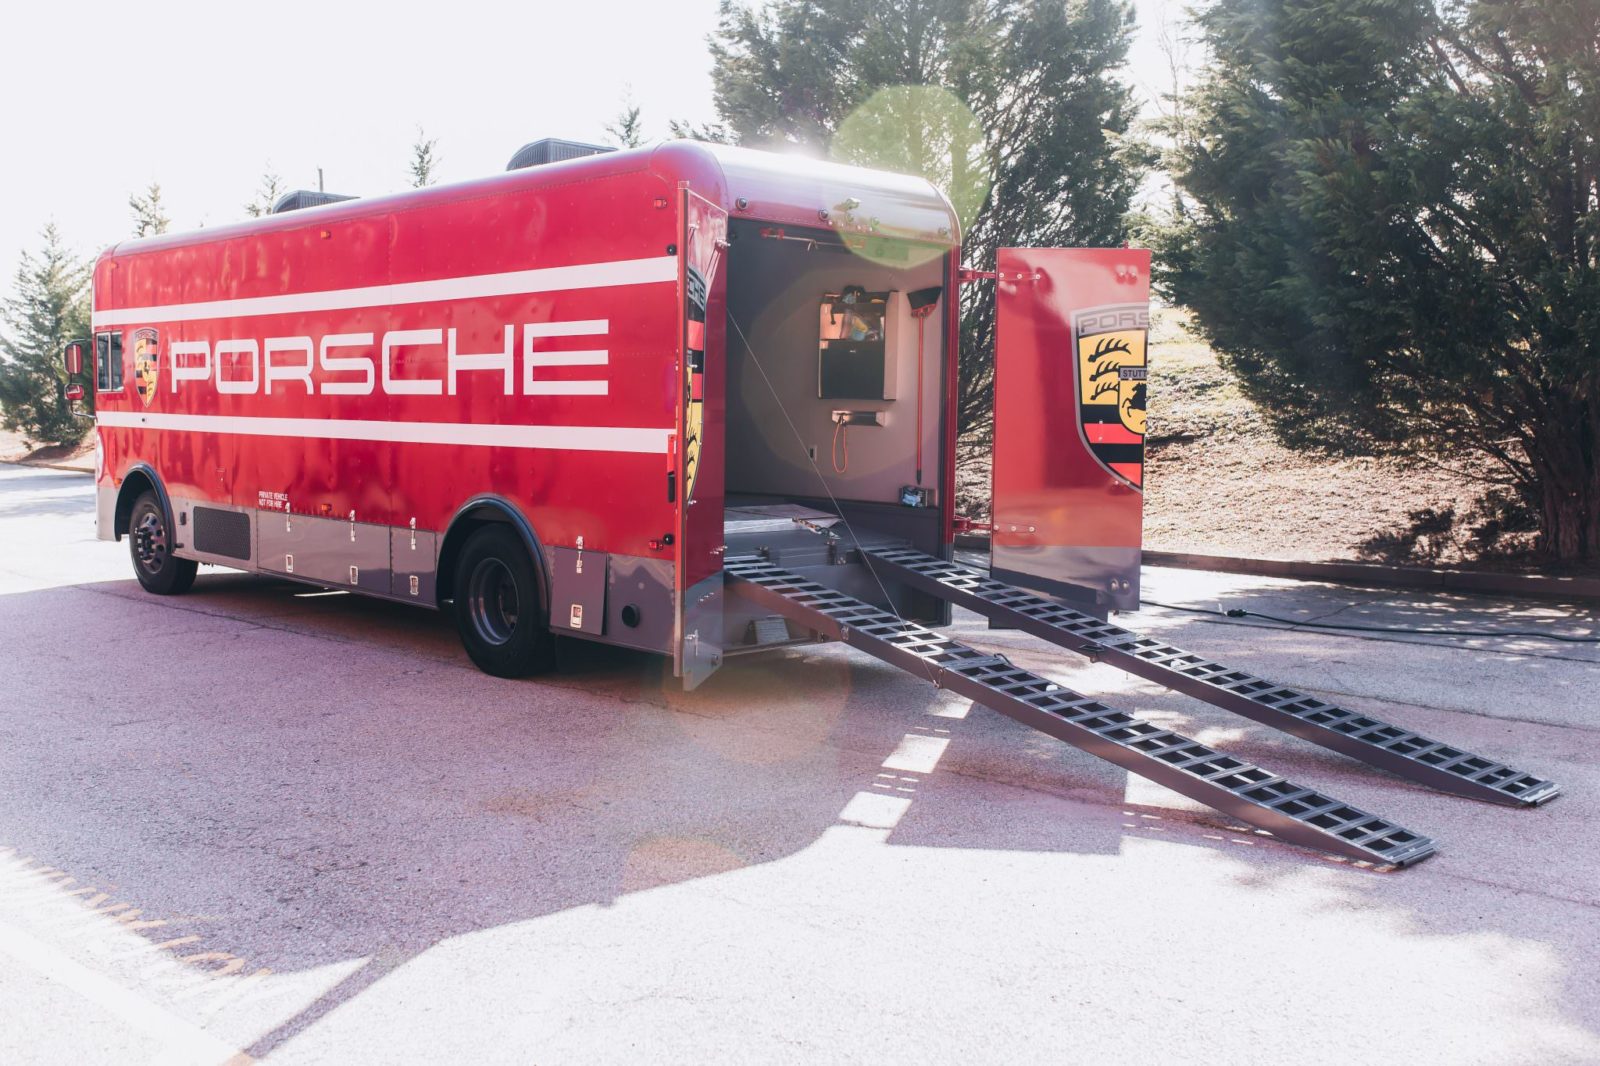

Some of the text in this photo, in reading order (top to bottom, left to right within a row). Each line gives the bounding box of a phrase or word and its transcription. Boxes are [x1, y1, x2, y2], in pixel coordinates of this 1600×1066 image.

[171, 319, 608, 395] PORSCHE
[258, 491, 288, 501] PRIVATE VEHICLE
